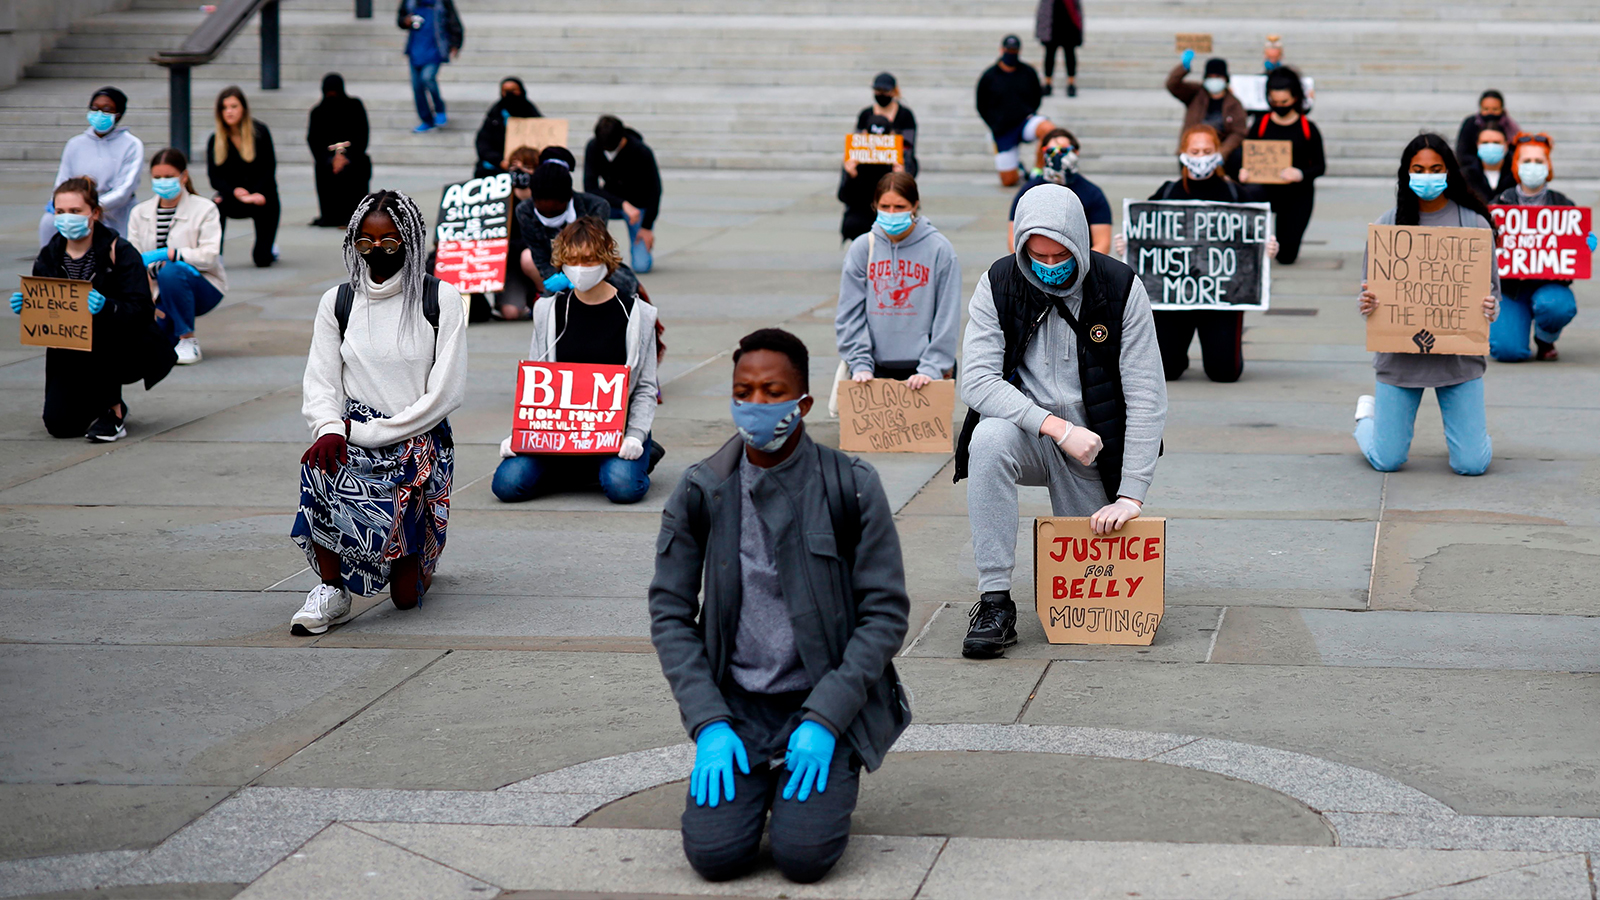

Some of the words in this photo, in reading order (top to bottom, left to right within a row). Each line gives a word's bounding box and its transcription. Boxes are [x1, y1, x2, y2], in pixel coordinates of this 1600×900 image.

[852, 134, 896, 148] SILENCE
[849, 149, 898, 165] VIOLENCE
[442, 173, 512, 209] ACAB
[446, 202, 505, 221] Silence
[1491, 208, 1583, 236] COLOUR
[1126, 211, 1185, 241] WHITE
[1195, 212, 1266, 243] PEOPLE
[1374, 230, 1412, 260] NO
[1416, 233, 1480, 262] JUSTICE
[1503, 235, 1516, 249] IS
[1518, 235, 1545, 249] NOT
[1546, 235, 1558, 249] A
[1040, 266, 1069, 278] BLACK
[1139, 247, 1193, 276] MUST
[1209, 247, 1236, 277] DO
[1374, 258, 1409, 281] NO
[1419, 261, 1474, 284] PEACE
[1495, 248, 1577, 276] CRIME
[24, 283, 79, 299] WHITE
[1163, 276, 1231, 306] MORE
[1395, 281, 1470, 308] PROSECUTE
[24, 299, 78, 312] SILENCE
[1384, 304, 1416, 326] THE
[1424, 307, 1467, 330] POLICE
[24, 324, 88, 340] VIOLENCE
[520, 366, 625, 411] BLM
[849, 382, 930, 413] BLACK
[519, 407, 561, 420] HOW
[568, 410, 616, 423] MANY
[529, 420, 553, 430] MORE
[556, 421, 577, 431] WILL
[581, 422, 595, 431] BE
[853, 408, 906, 435] LIVES
[519, 430, 566, 450] TREATED
[569, 432, 579, 440] AS
[572, 439, 594, 450] THEY
[594, 429, 623, 449] DON'T
[1049, 536, 1160, 562] JUSTICE
[1084, 564, 1114, 578] FOR
[1052, 576, 1144, 599] BELLY
[1050, 606, 1159, 637] MUJINGA
